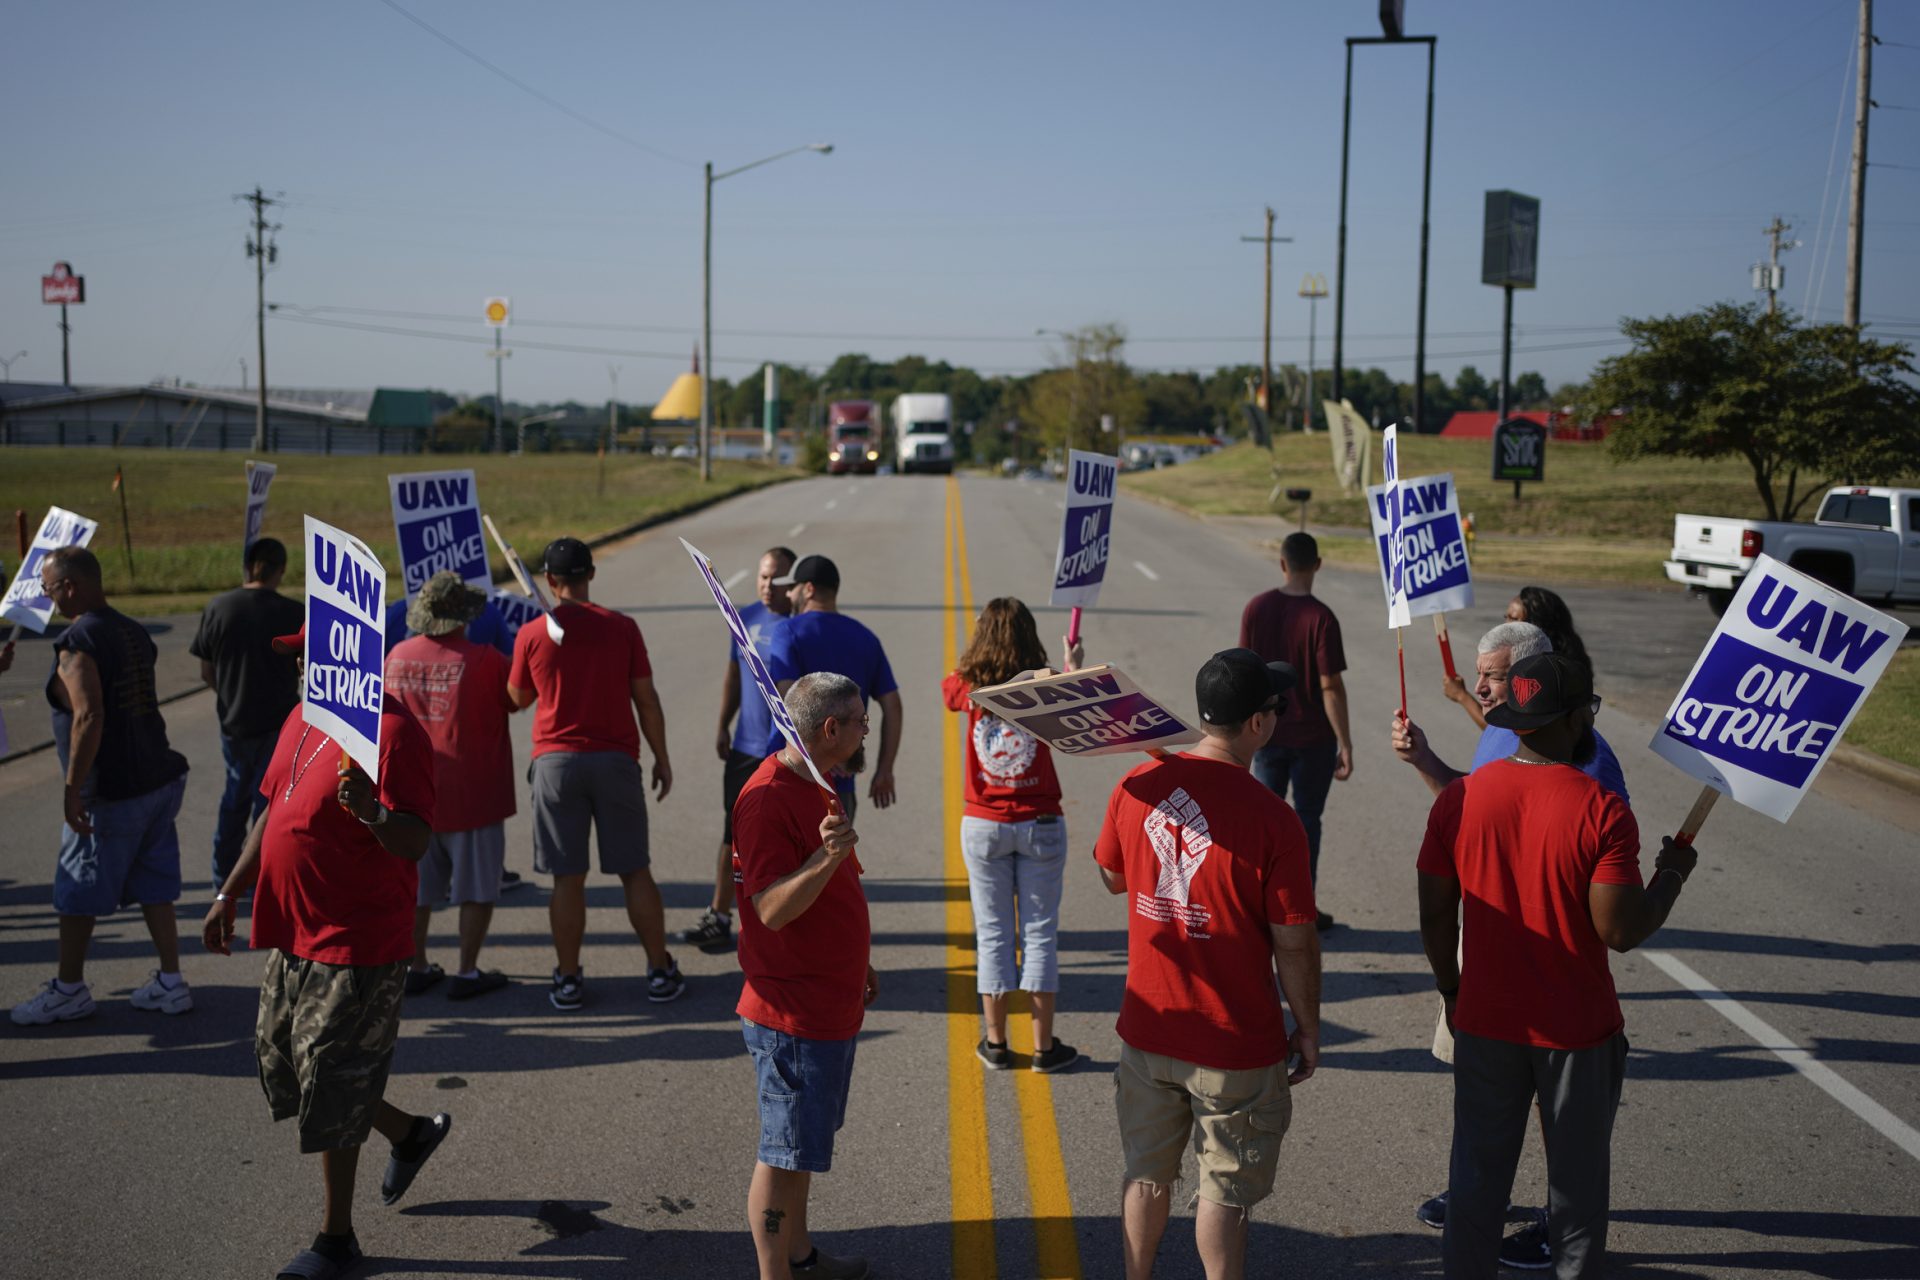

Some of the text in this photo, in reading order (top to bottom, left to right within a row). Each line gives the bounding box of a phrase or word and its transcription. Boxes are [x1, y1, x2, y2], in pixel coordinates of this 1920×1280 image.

[398, 478, 469, 510] UAW
[1074, 460, 1115, 498] UAW
[422, 516, 454, 551] ON
[1080, 509, 1101, 545] ON
[1404, 523, 1436, 562] ON
[314, 533, 382, 622] UAW
[406, 533, 483, 590] STRIKE
[1057, 533, 1109, 585] STRIKE
[1404, 539, 1465, 595] TRIKE
[329, 619, 362, 664] ON
[1746, 573, 1891, 675] UAW
[308, 662, 382, 713] STRIKE
[986, 673, 1122, 710] UAW
[1735, 663, 1810, 710] ON
[1051, 706, 1172, 753] STRIKE
[1058, 705, 1115, 731] ON
[1669, 697, 1838, 760] STRIKE
